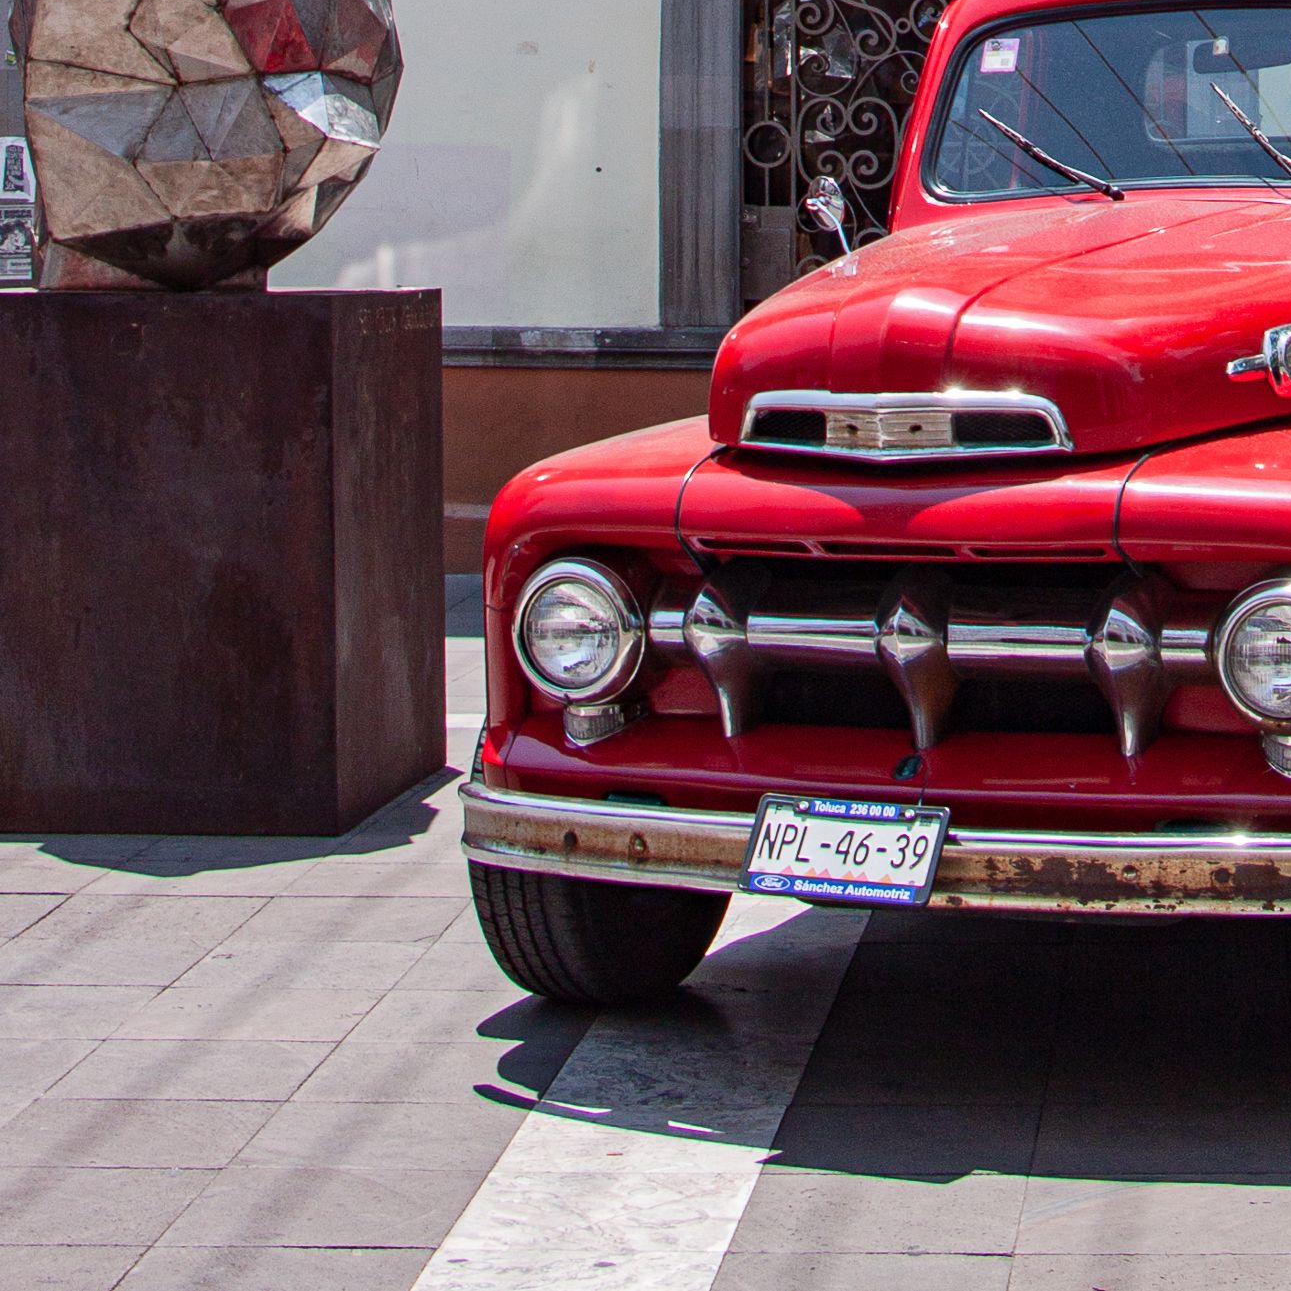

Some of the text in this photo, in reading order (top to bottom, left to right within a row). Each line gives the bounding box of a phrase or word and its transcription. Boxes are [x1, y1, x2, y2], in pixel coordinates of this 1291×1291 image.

[814, 800, 896, 817] Toluca 236 00 00
[761, 877, 784, 889] Ford
[793, 879, 911, 900] Sánchez Automotriz
